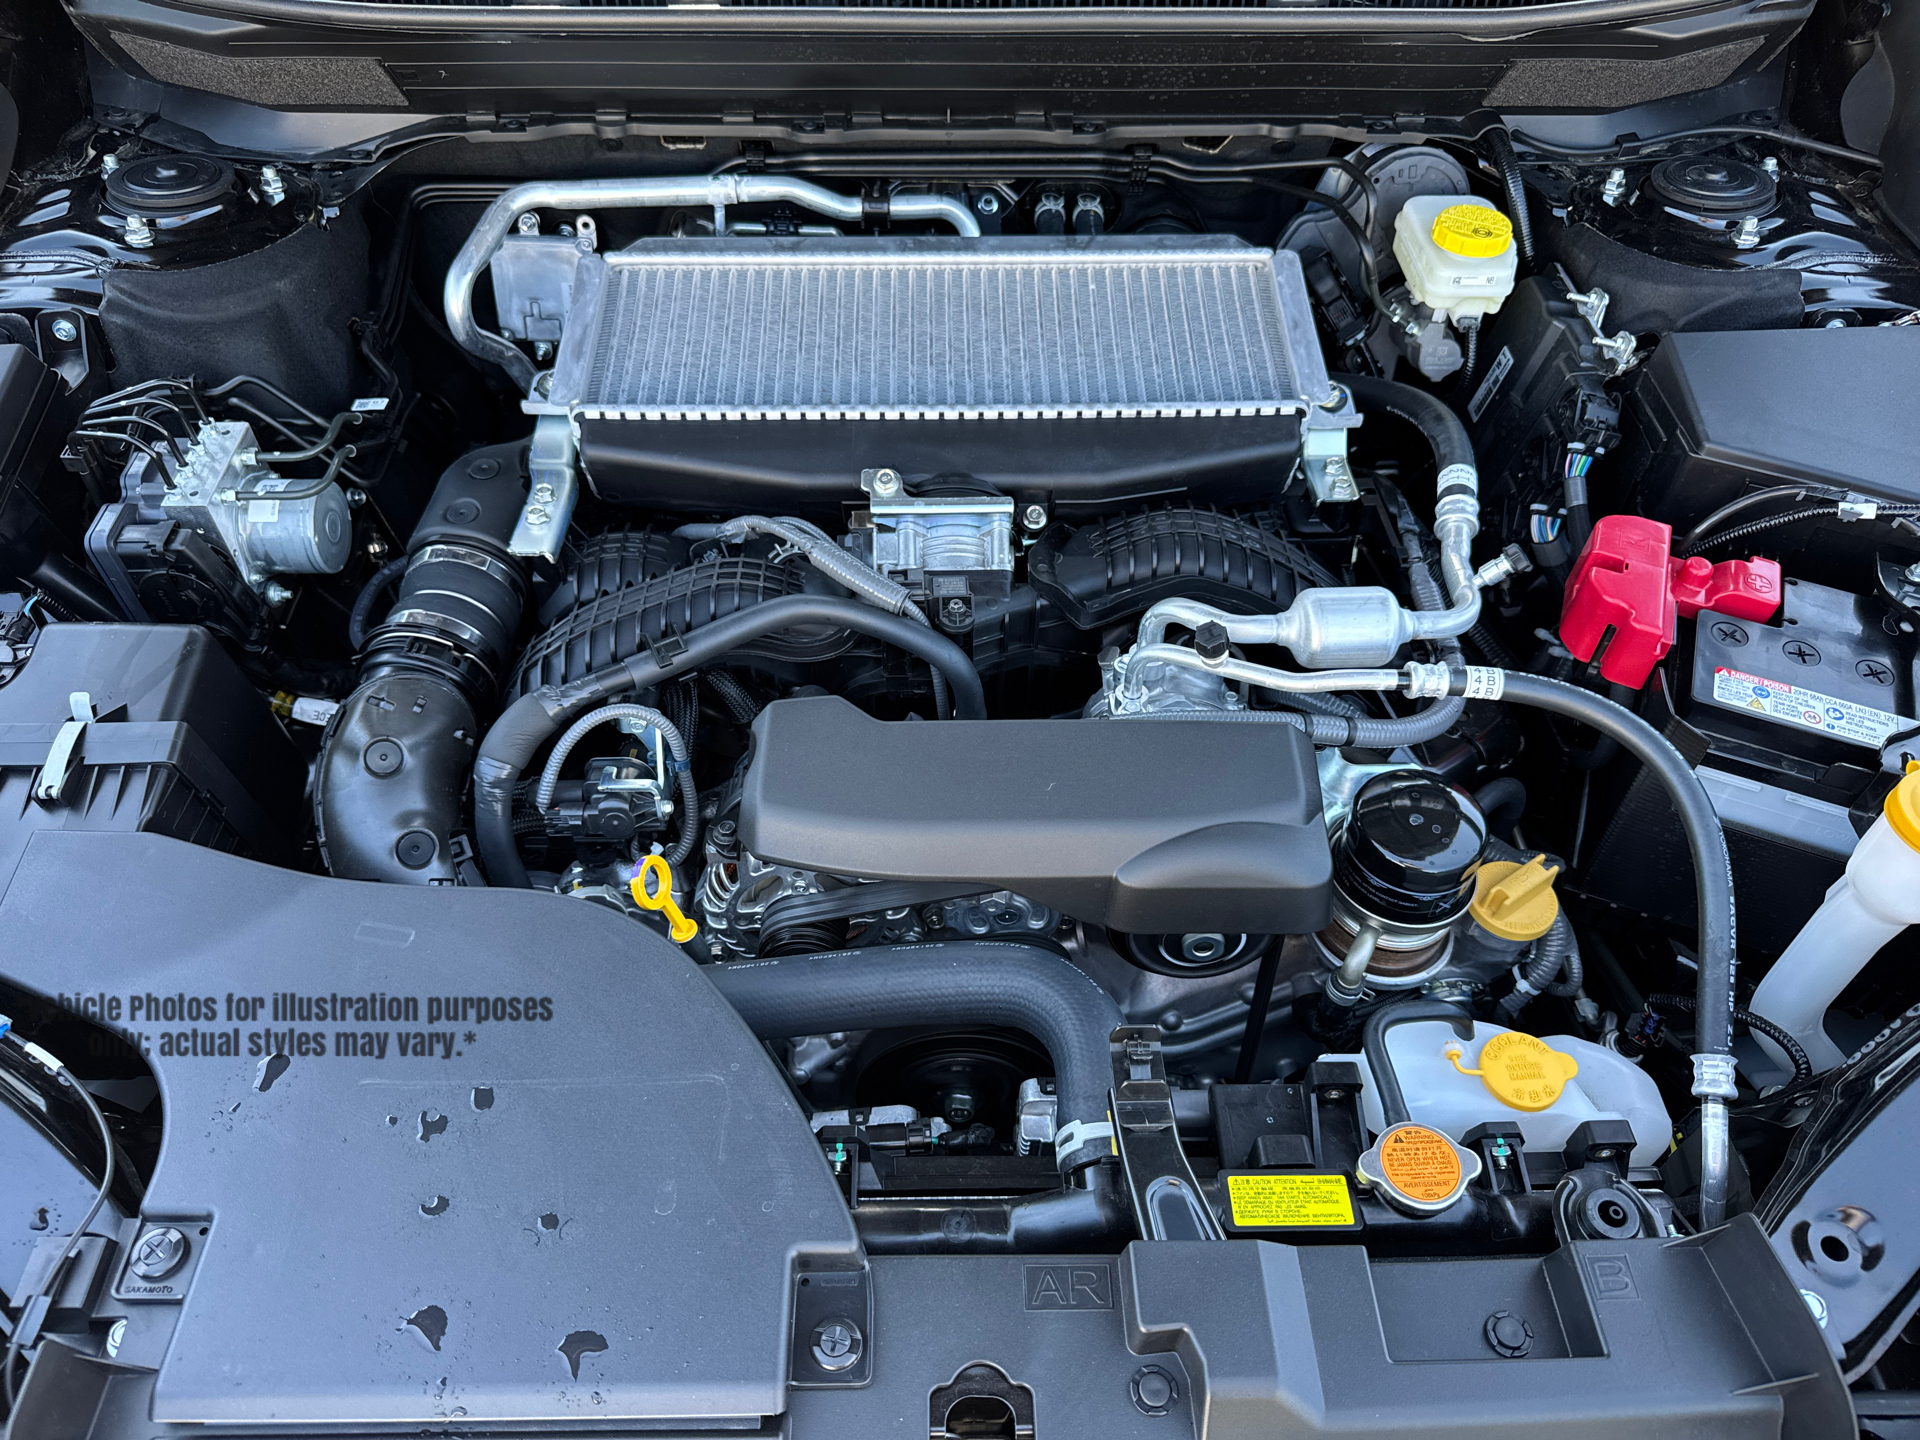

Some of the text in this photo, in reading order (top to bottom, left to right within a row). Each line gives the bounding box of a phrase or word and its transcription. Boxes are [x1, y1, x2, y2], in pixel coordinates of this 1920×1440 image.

[1730, 671, 1758, 684] DANGER
[1764, 680, 1788, 692] POISON
[1824, 697, 1838, 706] CCA
[1718, 830, 1734, 888] YOKOHAMA
[1485, 1035, 1550, 1060] COOLANT
[124, 1285, 174, 1294] SAKAMOTO
[1032, 1268, 1104, 1304] AR
[1594, 1260, 1632, 1296] B
